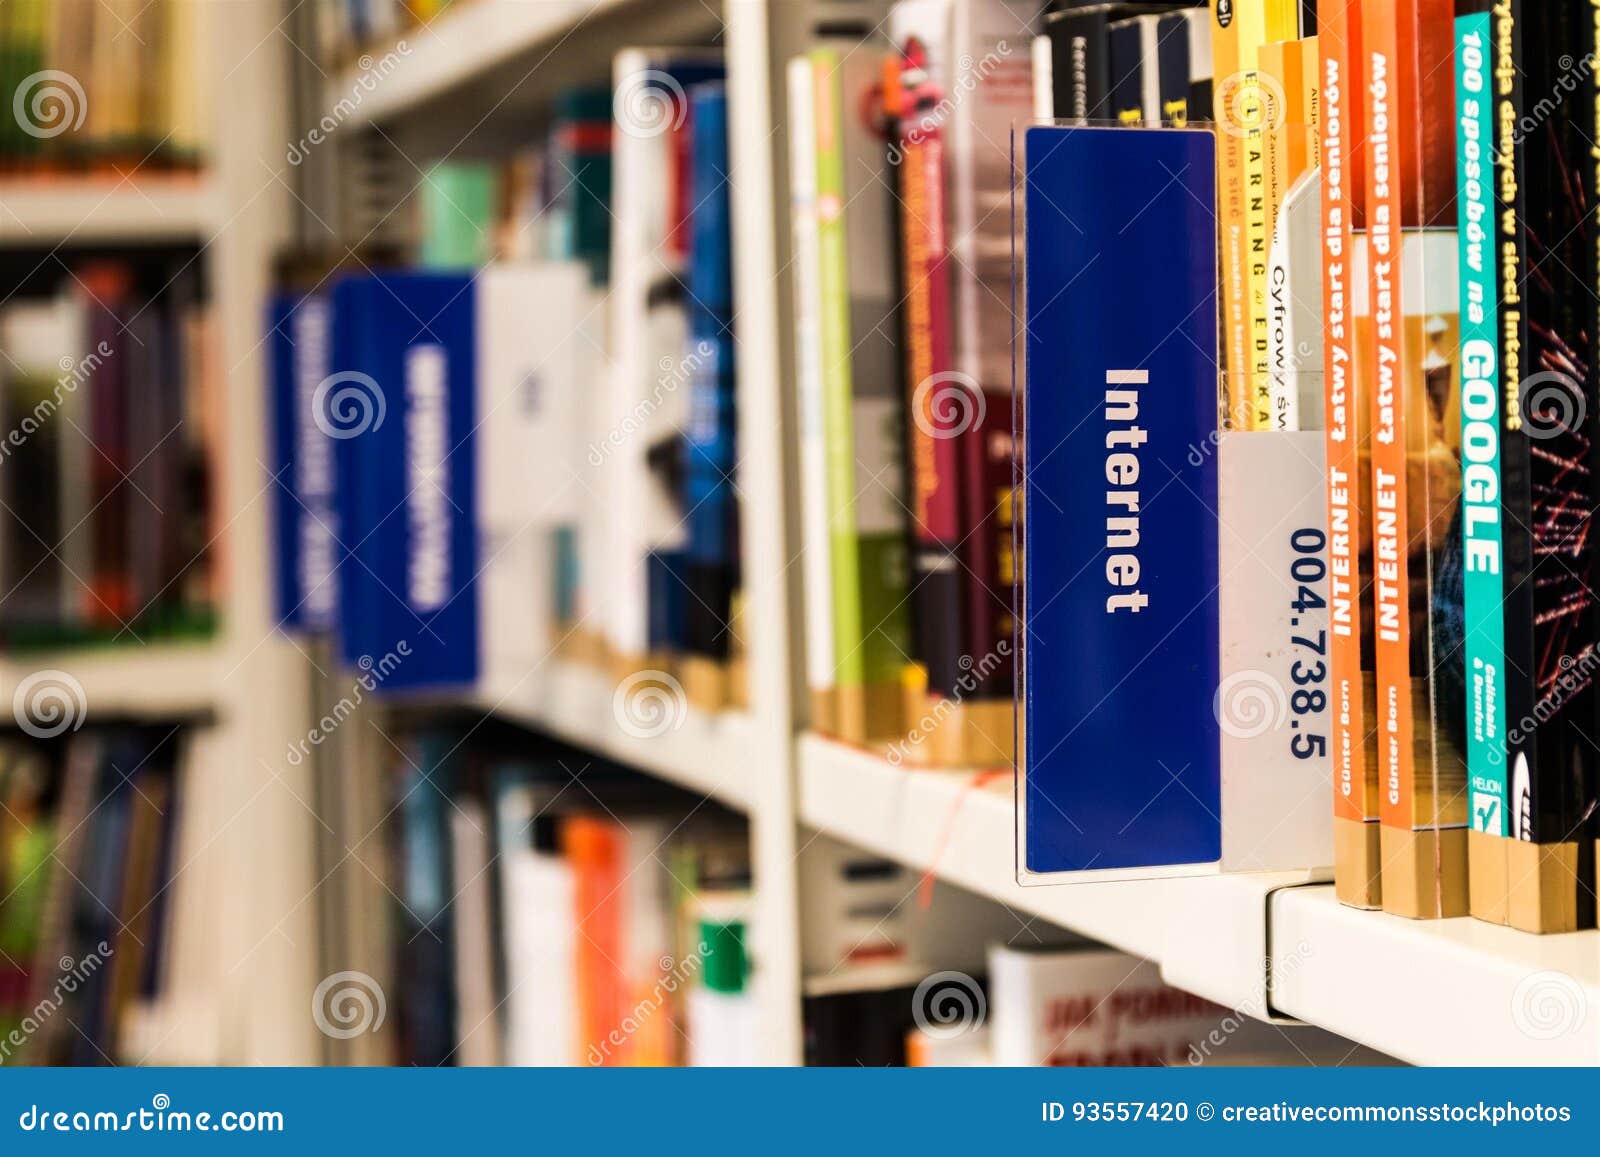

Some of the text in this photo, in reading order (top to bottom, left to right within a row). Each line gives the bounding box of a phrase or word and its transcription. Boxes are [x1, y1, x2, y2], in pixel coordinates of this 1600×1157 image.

[1498, 100, 1518, 203] danych
[1502, 208, 1517, 236] w
[1502, 241, 1521, 305] sieci
[1271, 265, 1287, 387] Cyfrowy
[1324, 58, 1351, 636] INTERNET Łatwy start dla seniorów
[1370, 51, 1399, 642] INTERNET Łatwy start dla seniorów
[1461, 31, 1500, 575] 100 sposobów na GOOGLE
[1504, 310, 1523, 431] Internet
[1105, 369, 1149, 613] Internet
[1290, 528, 1326, 760] 004.738.5
[1340, 680, 1351, 796] Günter Born
[1387, 685, 1399, 805] Günter Born
[1473, 674, 1484, 743] Dornfest
[1473, 777, 1502, 794] HELION
